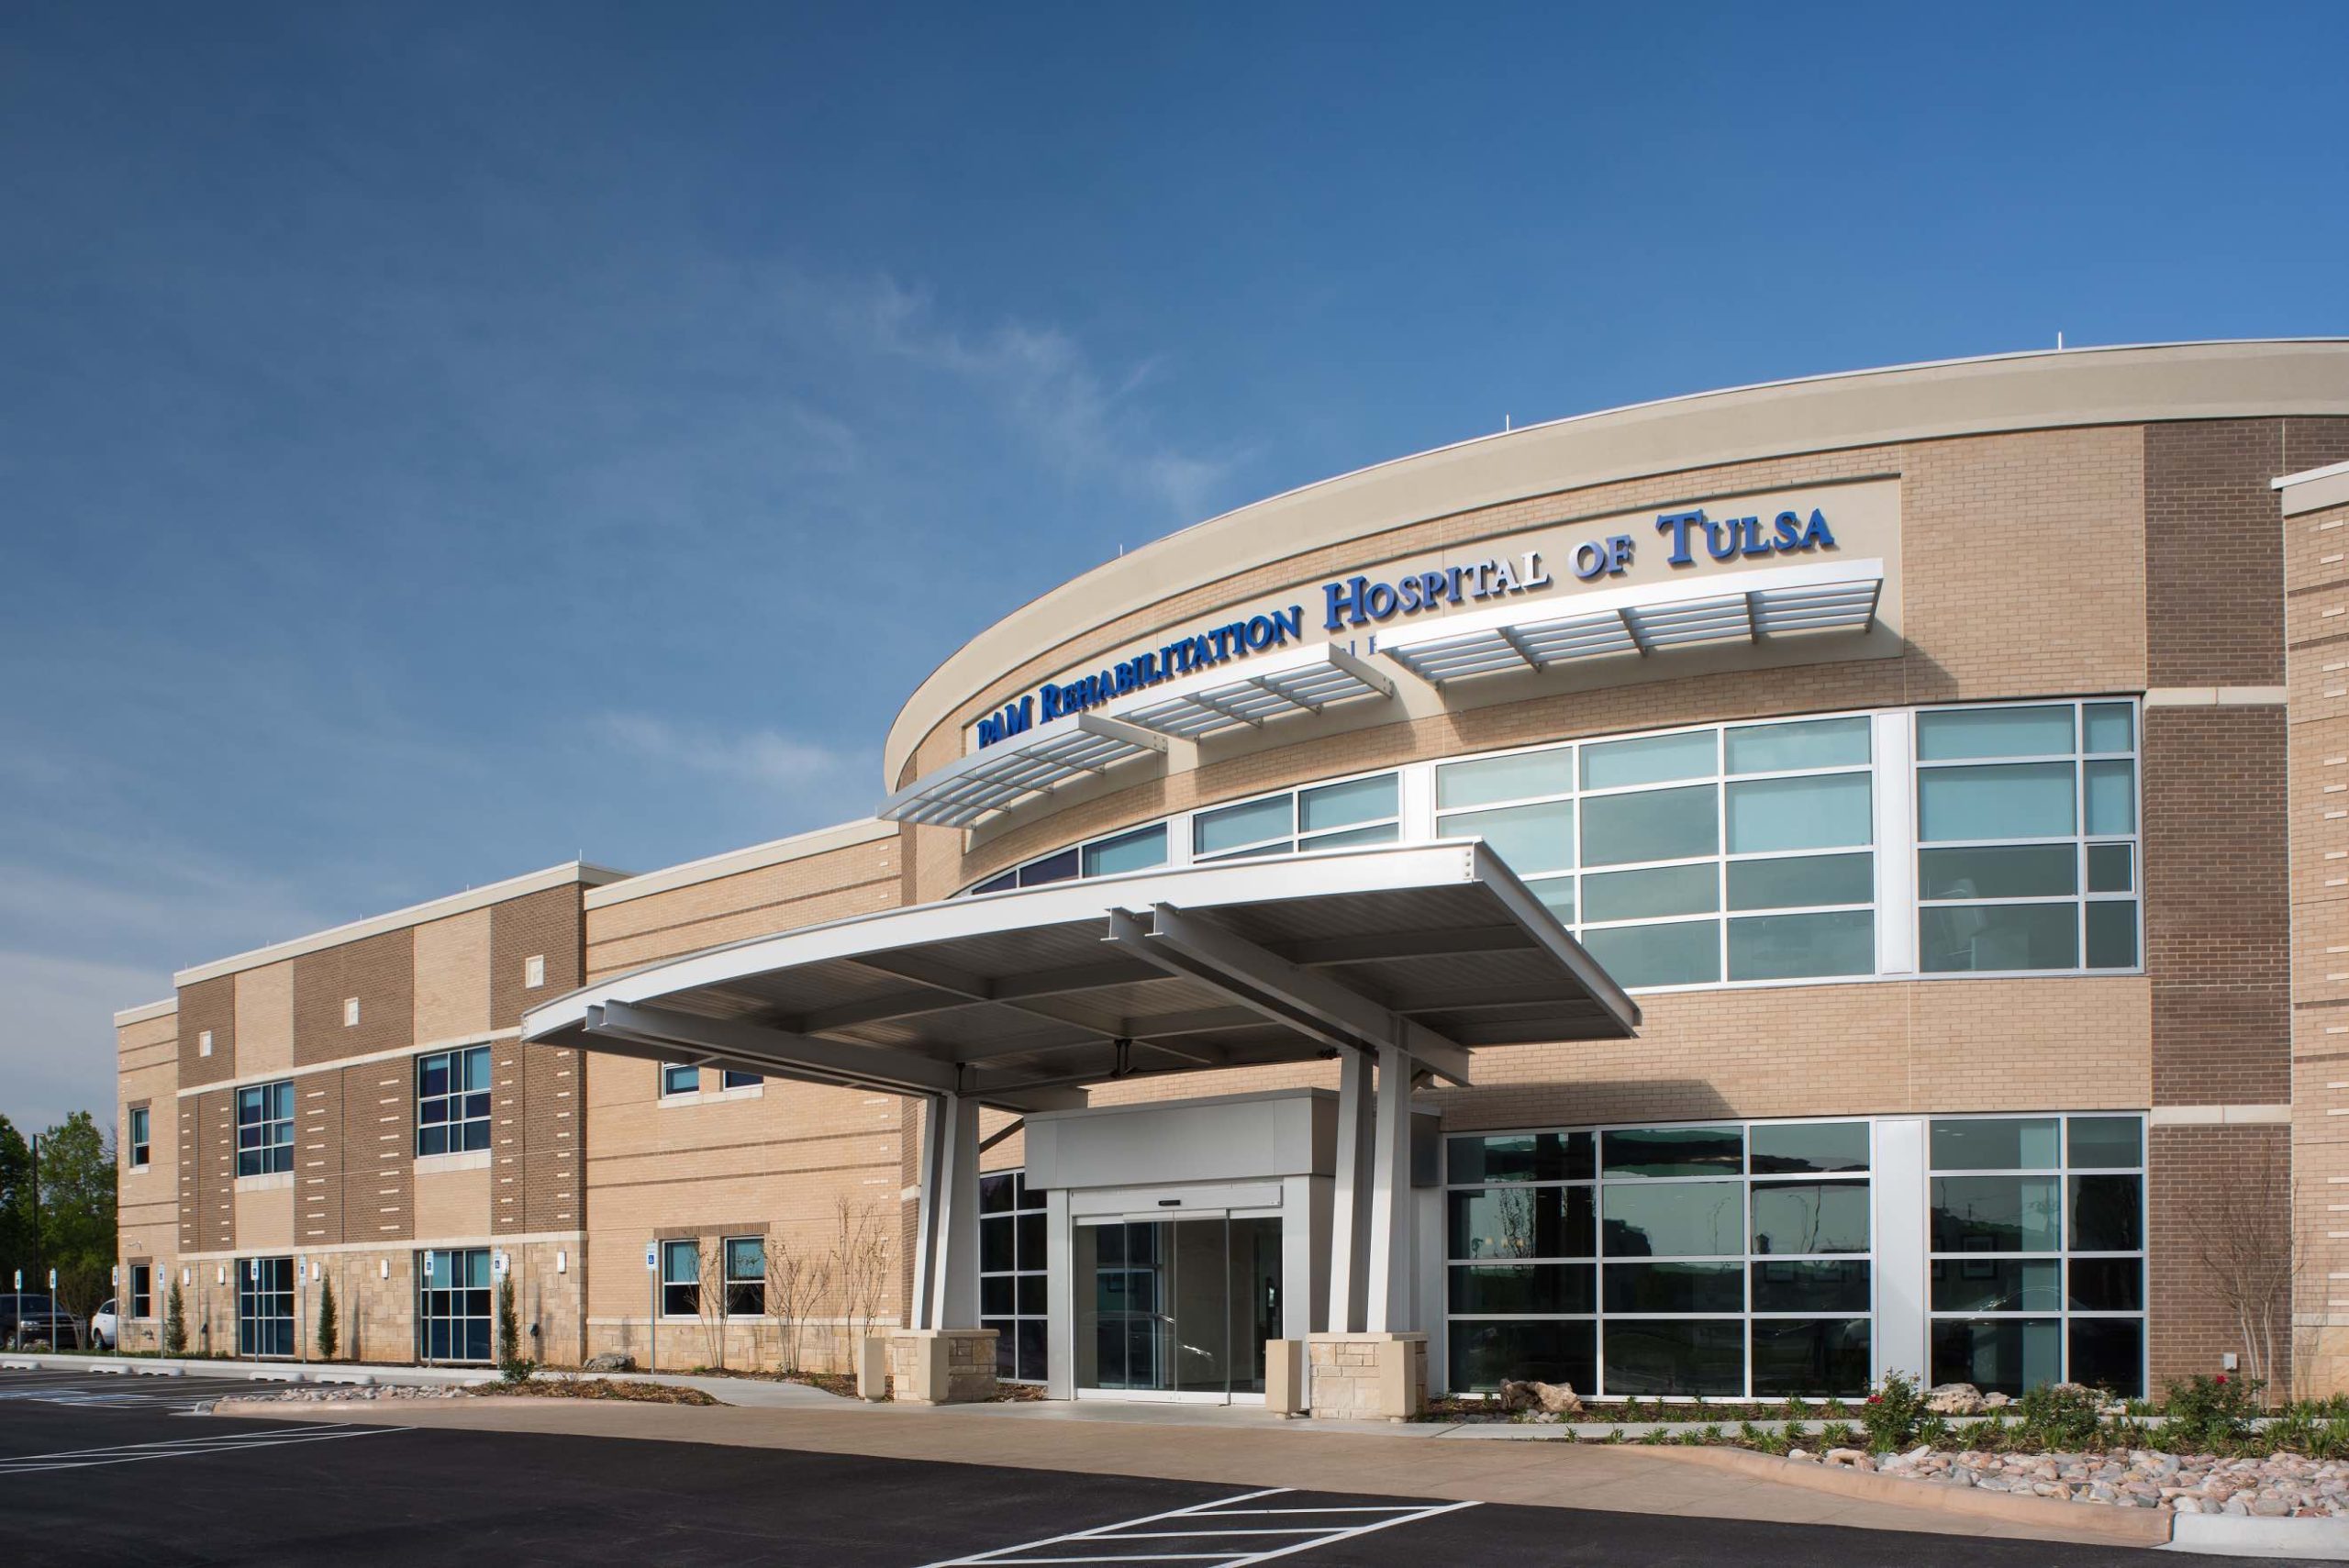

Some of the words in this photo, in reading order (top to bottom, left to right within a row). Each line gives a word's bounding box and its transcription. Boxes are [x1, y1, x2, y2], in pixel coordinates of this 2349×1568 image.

[977, 695, 1033, 750] PAM
[1040, 605, 1302, 724] REHABILITATION
[1322, 550, 1550, 630] HOSPITAL
[1568, 534, 1631, 578] OF
[1655, 508, 1834, 565] TULSA
